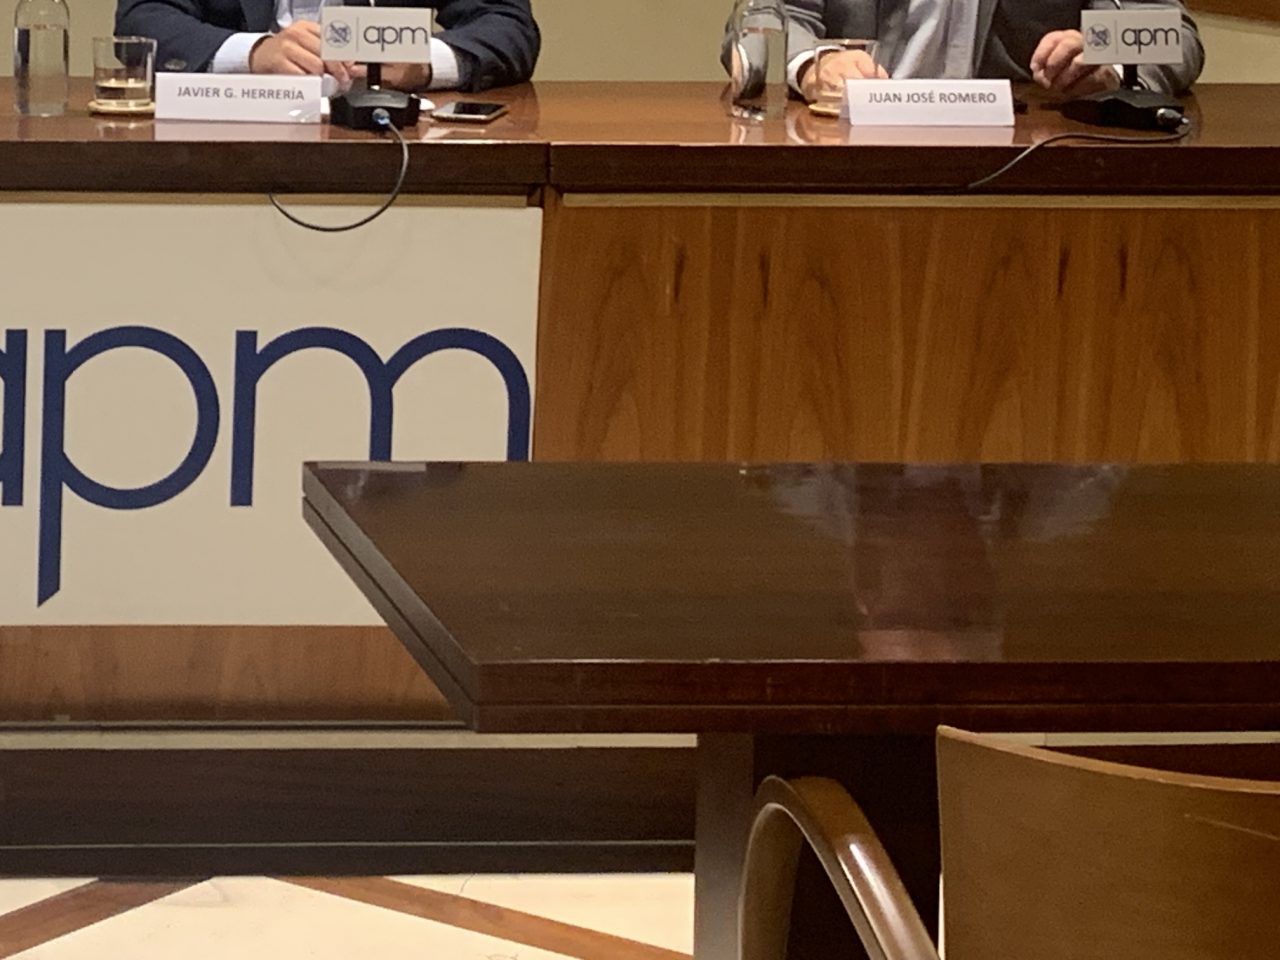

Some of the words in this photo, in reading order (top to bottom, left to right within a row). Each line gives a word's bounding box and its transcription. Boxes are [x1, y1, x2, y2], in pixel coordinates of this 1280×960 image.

[363, 24, 428, 52] apm
[1121, 26, 1180, 54] apm
[177, 86, 221, 98] JAVIER
[223, 87, 238, 99] G.
[241, 87, 305, 100] HERRERÍA
[868, 92, 903, 104] JUAN
[905, 90, 935, 104] JOSÉ
[939, 92, 997, 104] ROMERO
